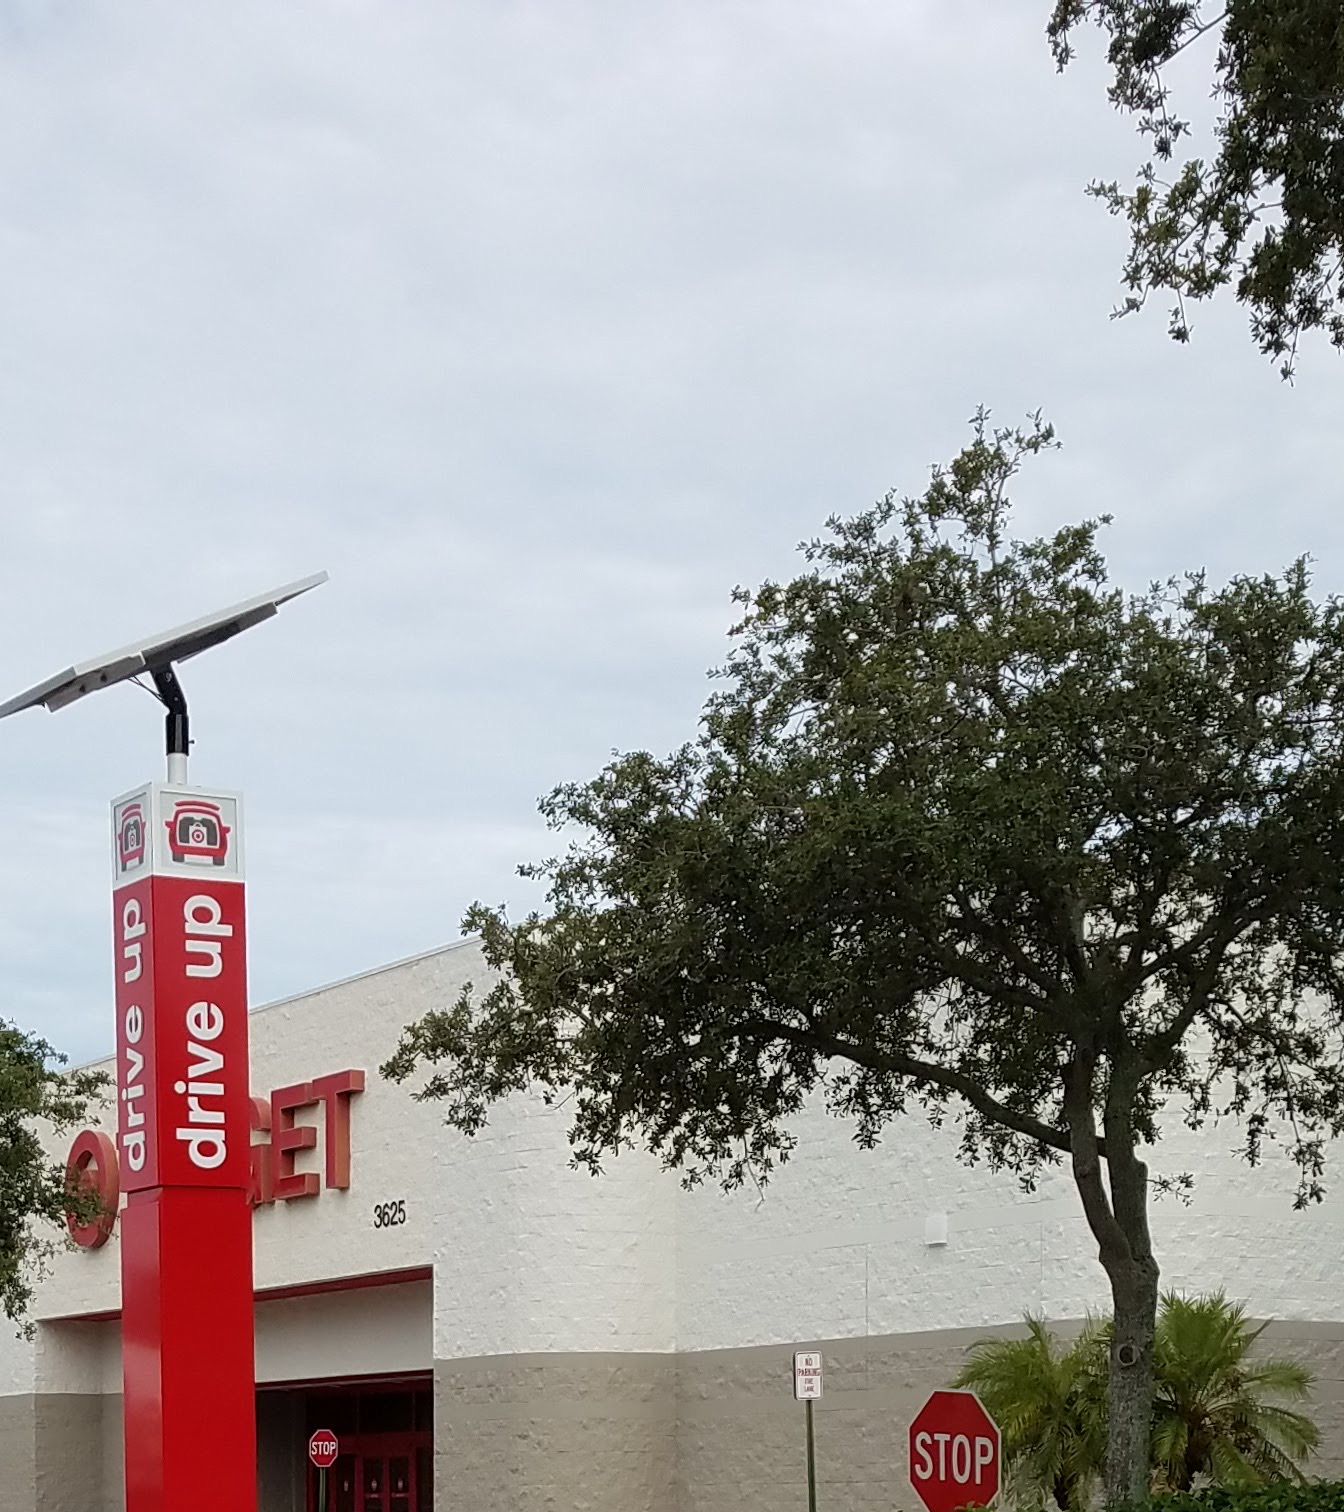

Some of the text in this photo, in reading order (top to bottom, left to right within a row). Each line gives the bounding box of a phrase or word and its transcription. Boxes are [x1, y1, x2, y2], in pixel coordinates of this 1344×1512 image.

[122, 898, 146, 1171] drive up
[174, 894, 233, 1169] drive up
[373, 1199, 406, 1229] 3625
[311, 1441, 336, 1455] STOP
[914, 1431, 994, 1485] STOP
